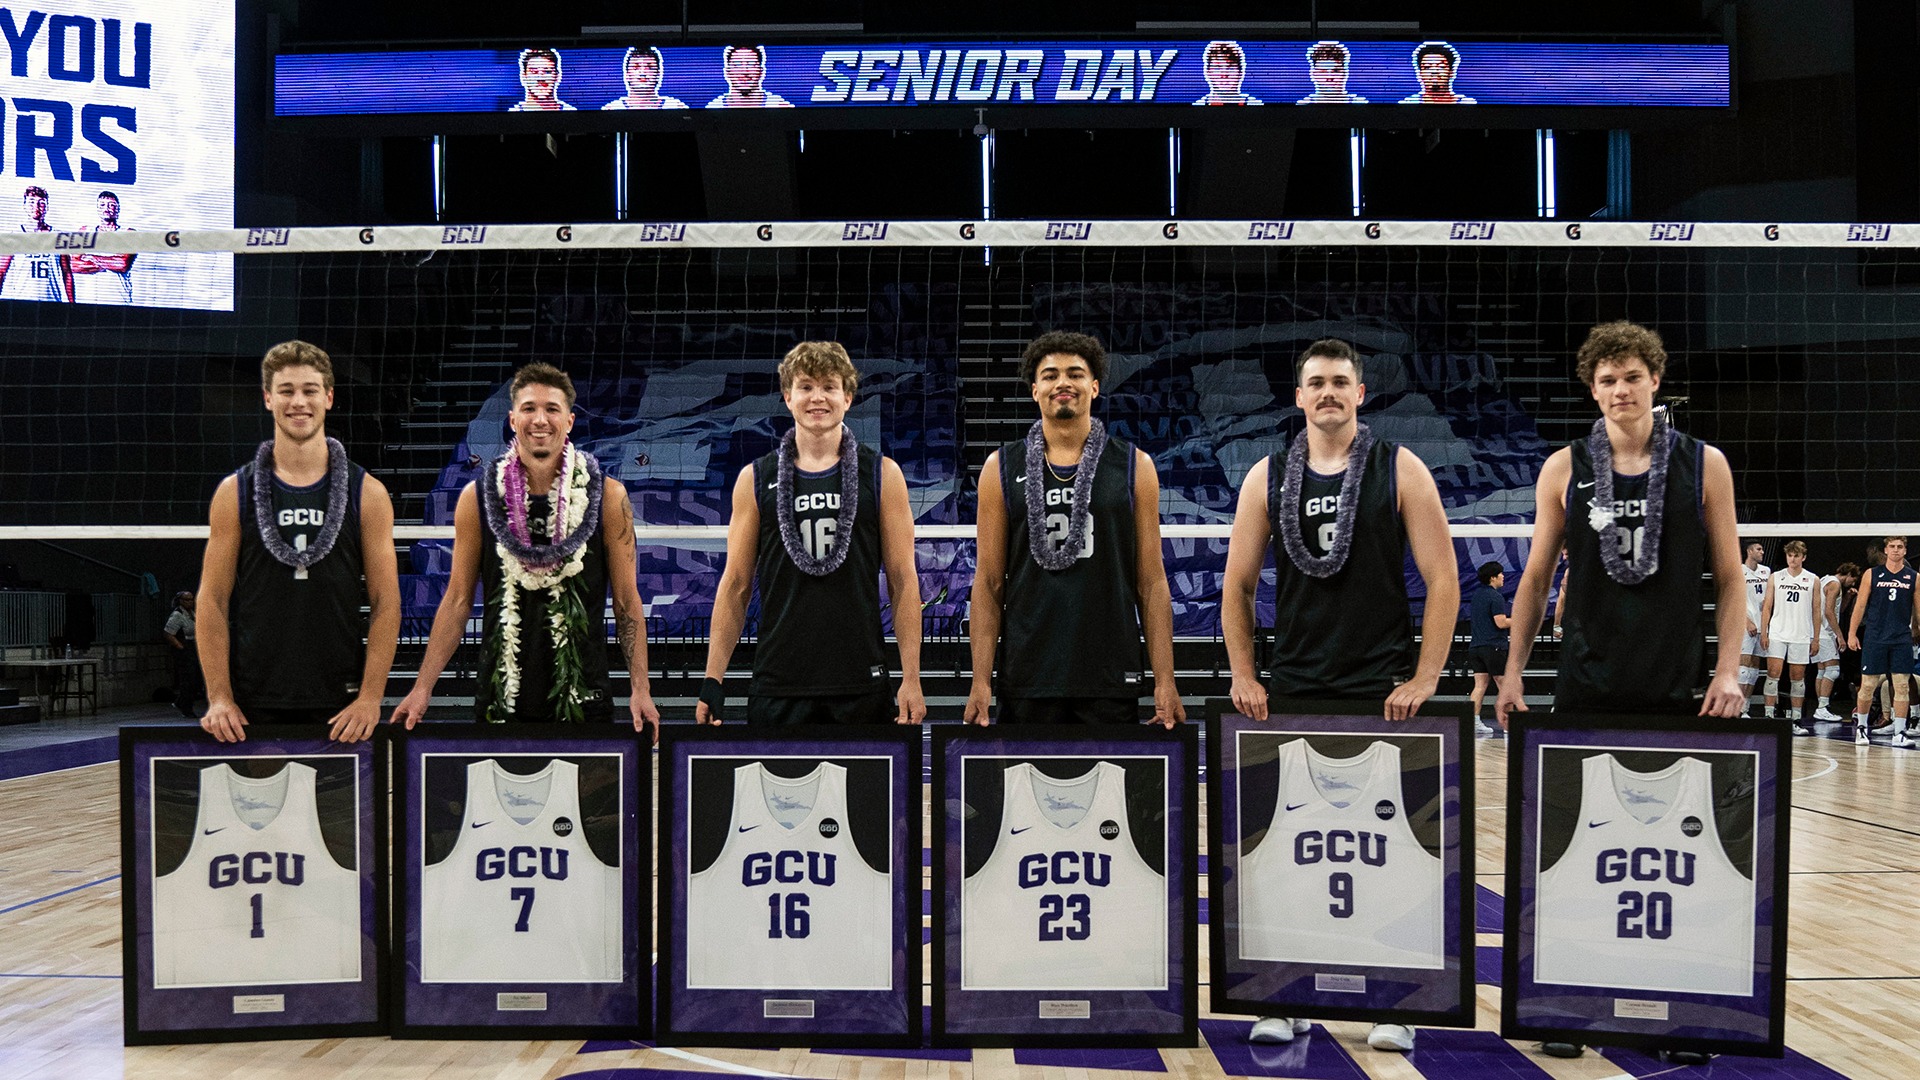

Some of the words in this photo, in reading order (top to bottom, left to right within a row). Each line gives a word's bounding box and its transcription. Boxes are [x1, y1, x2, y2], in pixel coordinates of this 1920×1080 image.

[0, 7, 152, 89] YOU
[811, 49, 1045, 102] SENIOR
[1055, 49, 1179, 101] DAY
[0, 97, 137, 186] RS
[55, 231, 98, 249] GCU
[164, 231, 181, 247] G
[246, 228, 290, 246] GCU
[359, 228, 375, 245] G
[441, 226, 486, 244] GCU
[556, 226, 572, 242] G
[640, 225, 686, 242] GCU
[757, 225, 773, 242] G
[842, 223, 888, 241] GCU
[959, 223, 975, 240] G
[1045, 223, 1092, 241] GCU
[1163, 223, 1179, 240] G
[1248, 223, 1295, 240] GCU
[1365, 223, 1381, 240] G
[1449, 223, 1495, 240] GCU
[1566, 224, 1581, 240] G
[1649, 223, 1695, 241] GCU
[1764, 225, 1780, 242] G
[1847, 224, 1891, 241] GCU
[30, 260, 49, 278] 16
[794, 492, 841, 512] GCU
[278, 508, 324, 526] GCU
[800, 517, 839, 560] 16
[294, 533, 309, 580] 1
[1745, 576, 1768, 584] PEPPERDIN
[1754, 584, 1763, 594] 14
[1779, 583, 1809, 591] PEPPERDINE
[1876, 579, 1911, 589] PEPPERDINE
[1786, 591, 1800, 603] 20
[1888, 588, 1897, 601] 3
[1294, 829, 1388, 868] GCU
[208, 851, 306, 890] GCU
[475, 845, 570, 882] GCU
[741, 849, 837, 888] GCU
[1018, 850, 1112, 890] GCU
[1595, 846, 1697, 887] GCU
[1328, 871, 1354, 919] 9
[249, 893, 266, 939] 1
[510, 886, 536, 933] 7
[768, 892, 811, 940] 16
[1038, 893, 1091, 942] 23
[1616, 890, 1673, 940] 20
